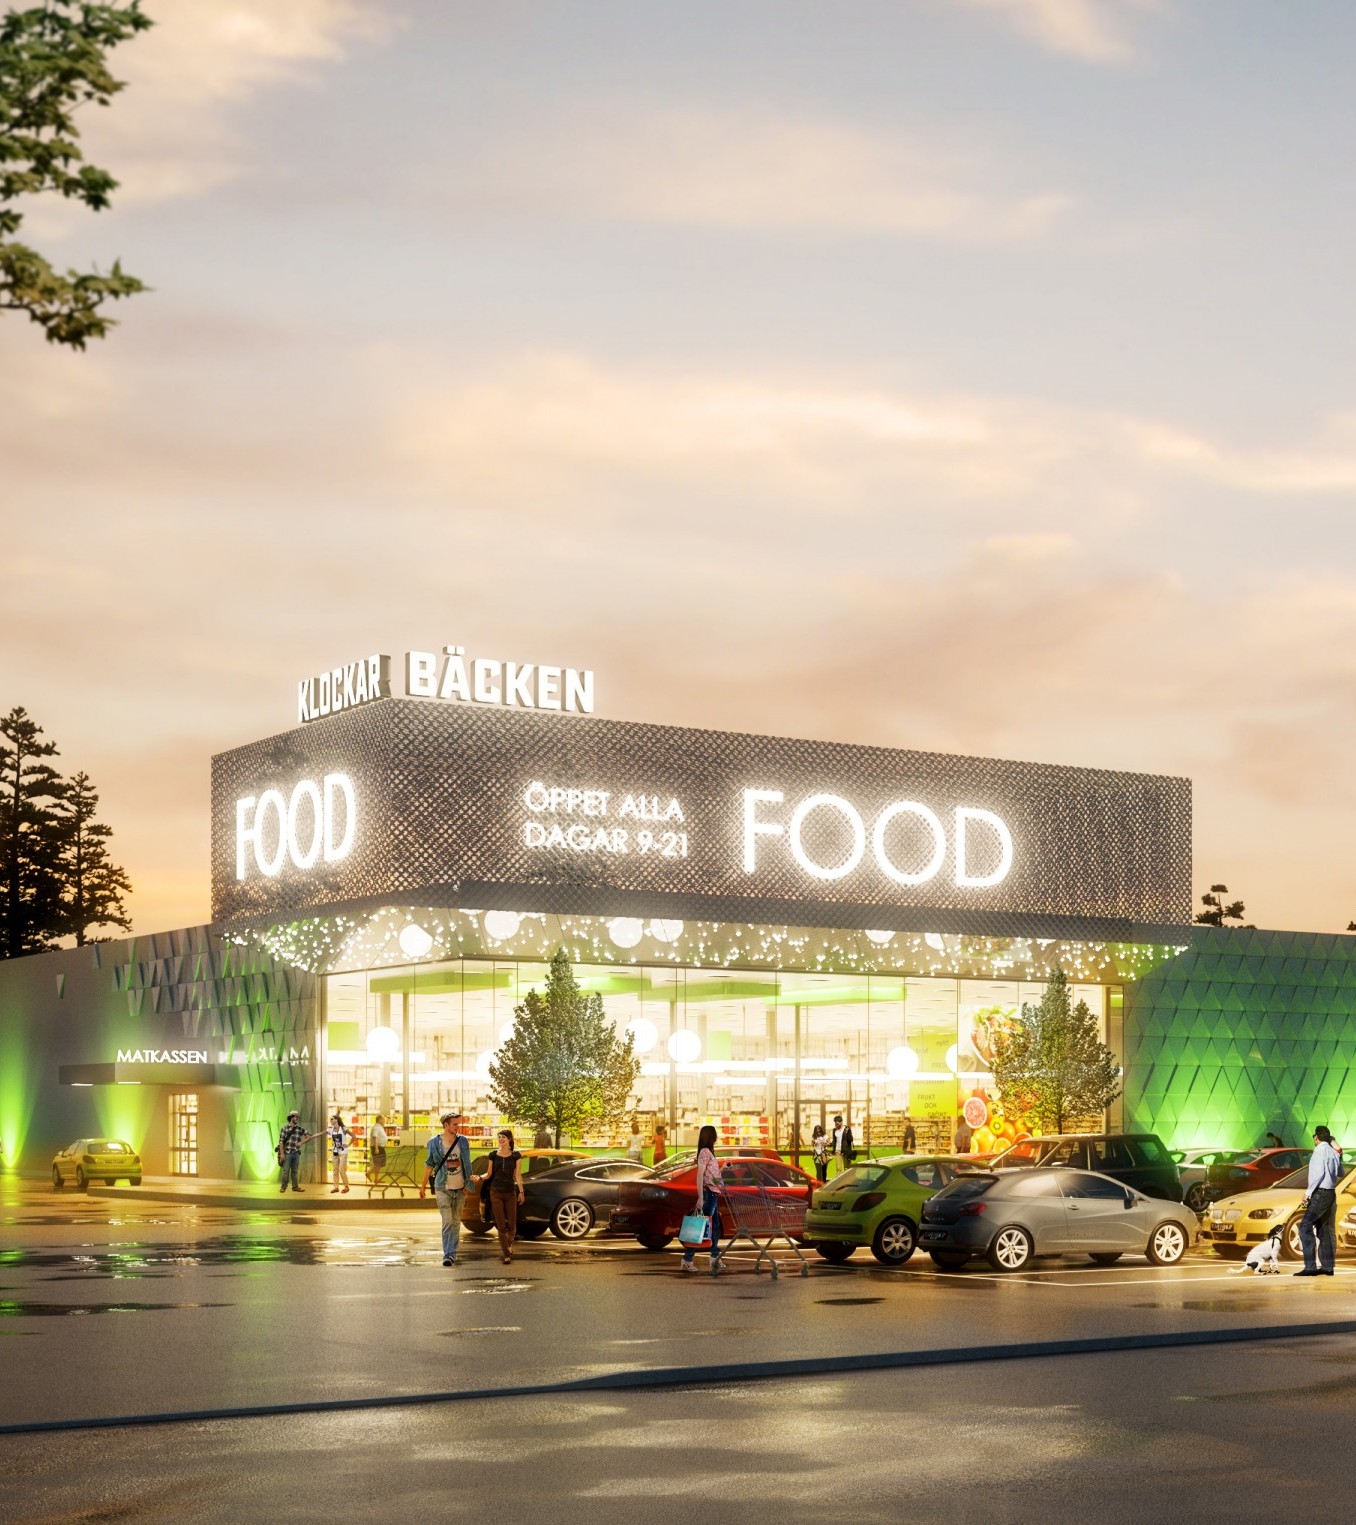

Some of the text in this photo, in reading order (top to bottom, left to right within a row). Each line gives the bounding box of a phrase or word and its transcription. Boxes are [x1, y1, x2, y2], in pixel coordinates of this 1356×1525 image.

[298, 653, 388, 723] KLOCKAR
[405, 645, 595, 713] BÄCKEN
[236, 773, 356, 880] FOOD
[524, 780, 686, 823] ÖPPET ALLA
[524, 822, 688, 858] DAGAR 9-21
[743, 789, 1013, 888] FOOD
[116, 1048, 208, 1064] MATKASSEN
